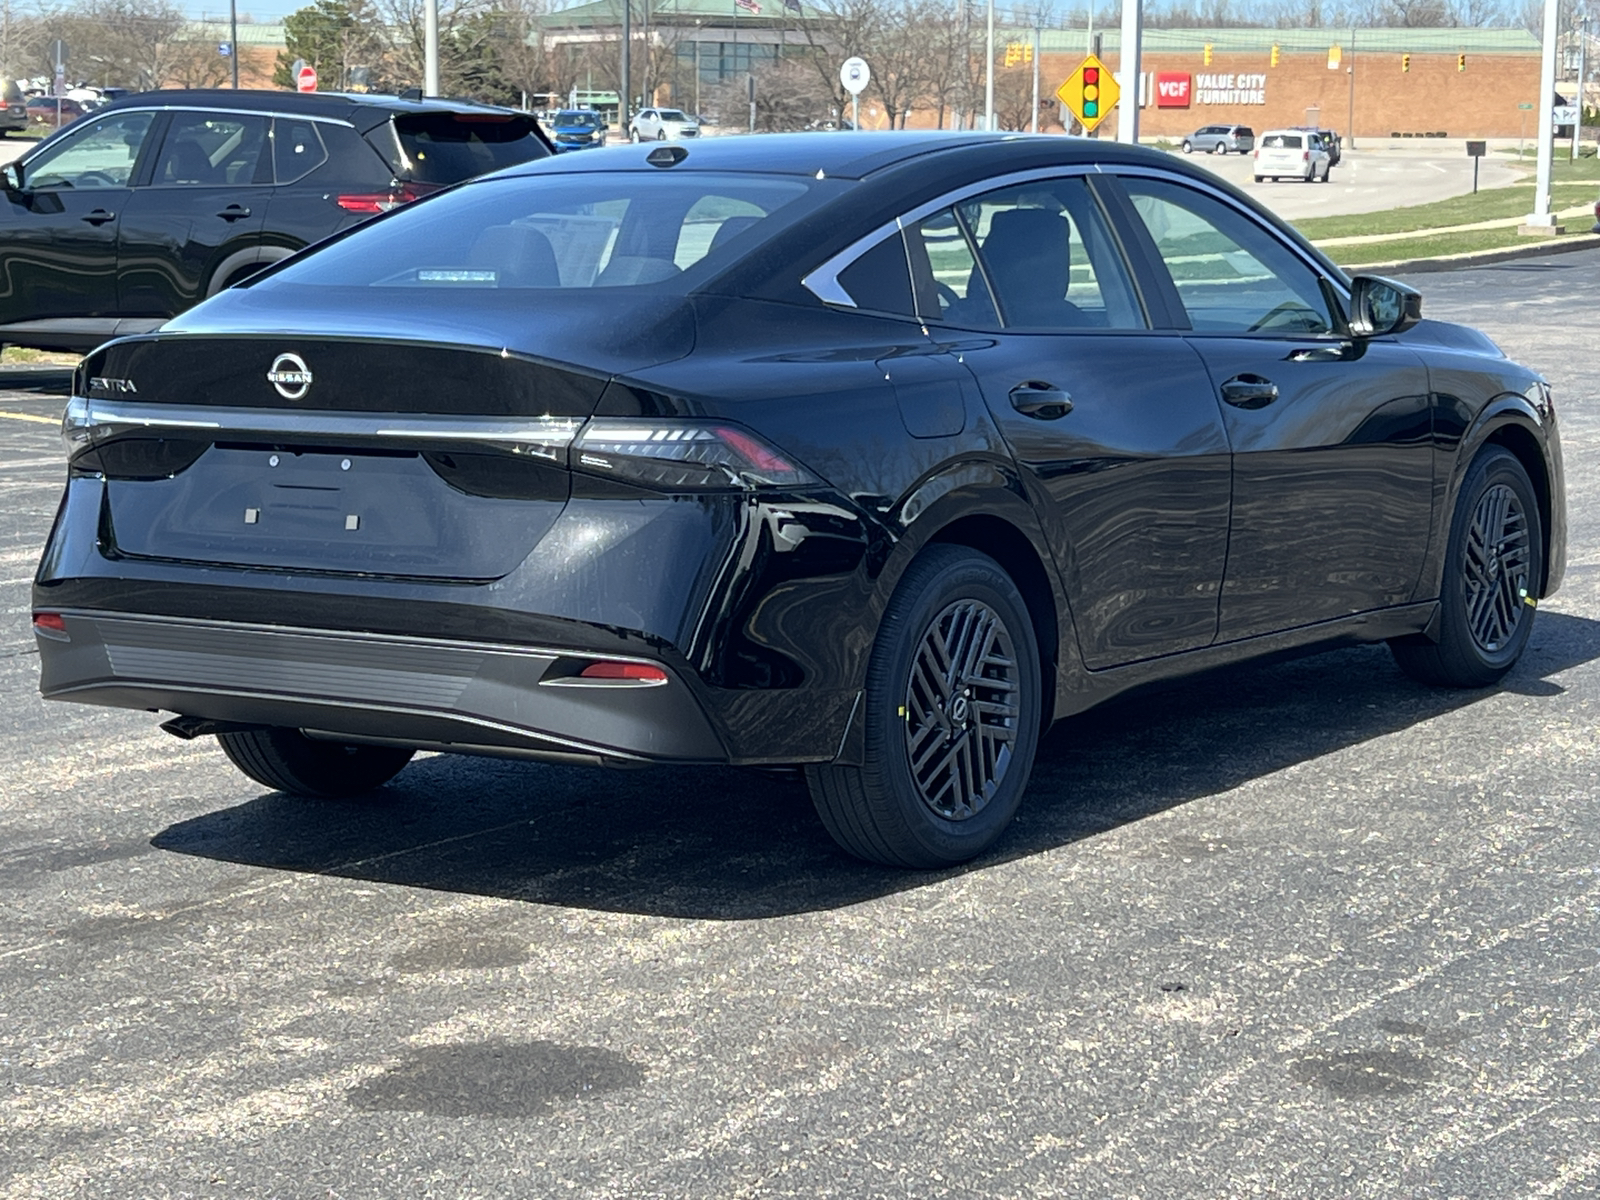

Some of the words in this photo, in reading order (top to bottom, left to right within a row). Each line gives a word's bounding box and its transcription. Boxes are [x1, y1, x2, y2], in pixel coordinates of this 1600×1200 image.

[1158, 81, 1188, 97] VCF
[1196, 74, 1234, 89] VALUE
[1237, 74, 1266, 89] CITY
[1196, 90, 1265, 105] FURNITURE
[267, 371, 312, 383] NISSAN
[89, 377, 137, 393] SENTRA
